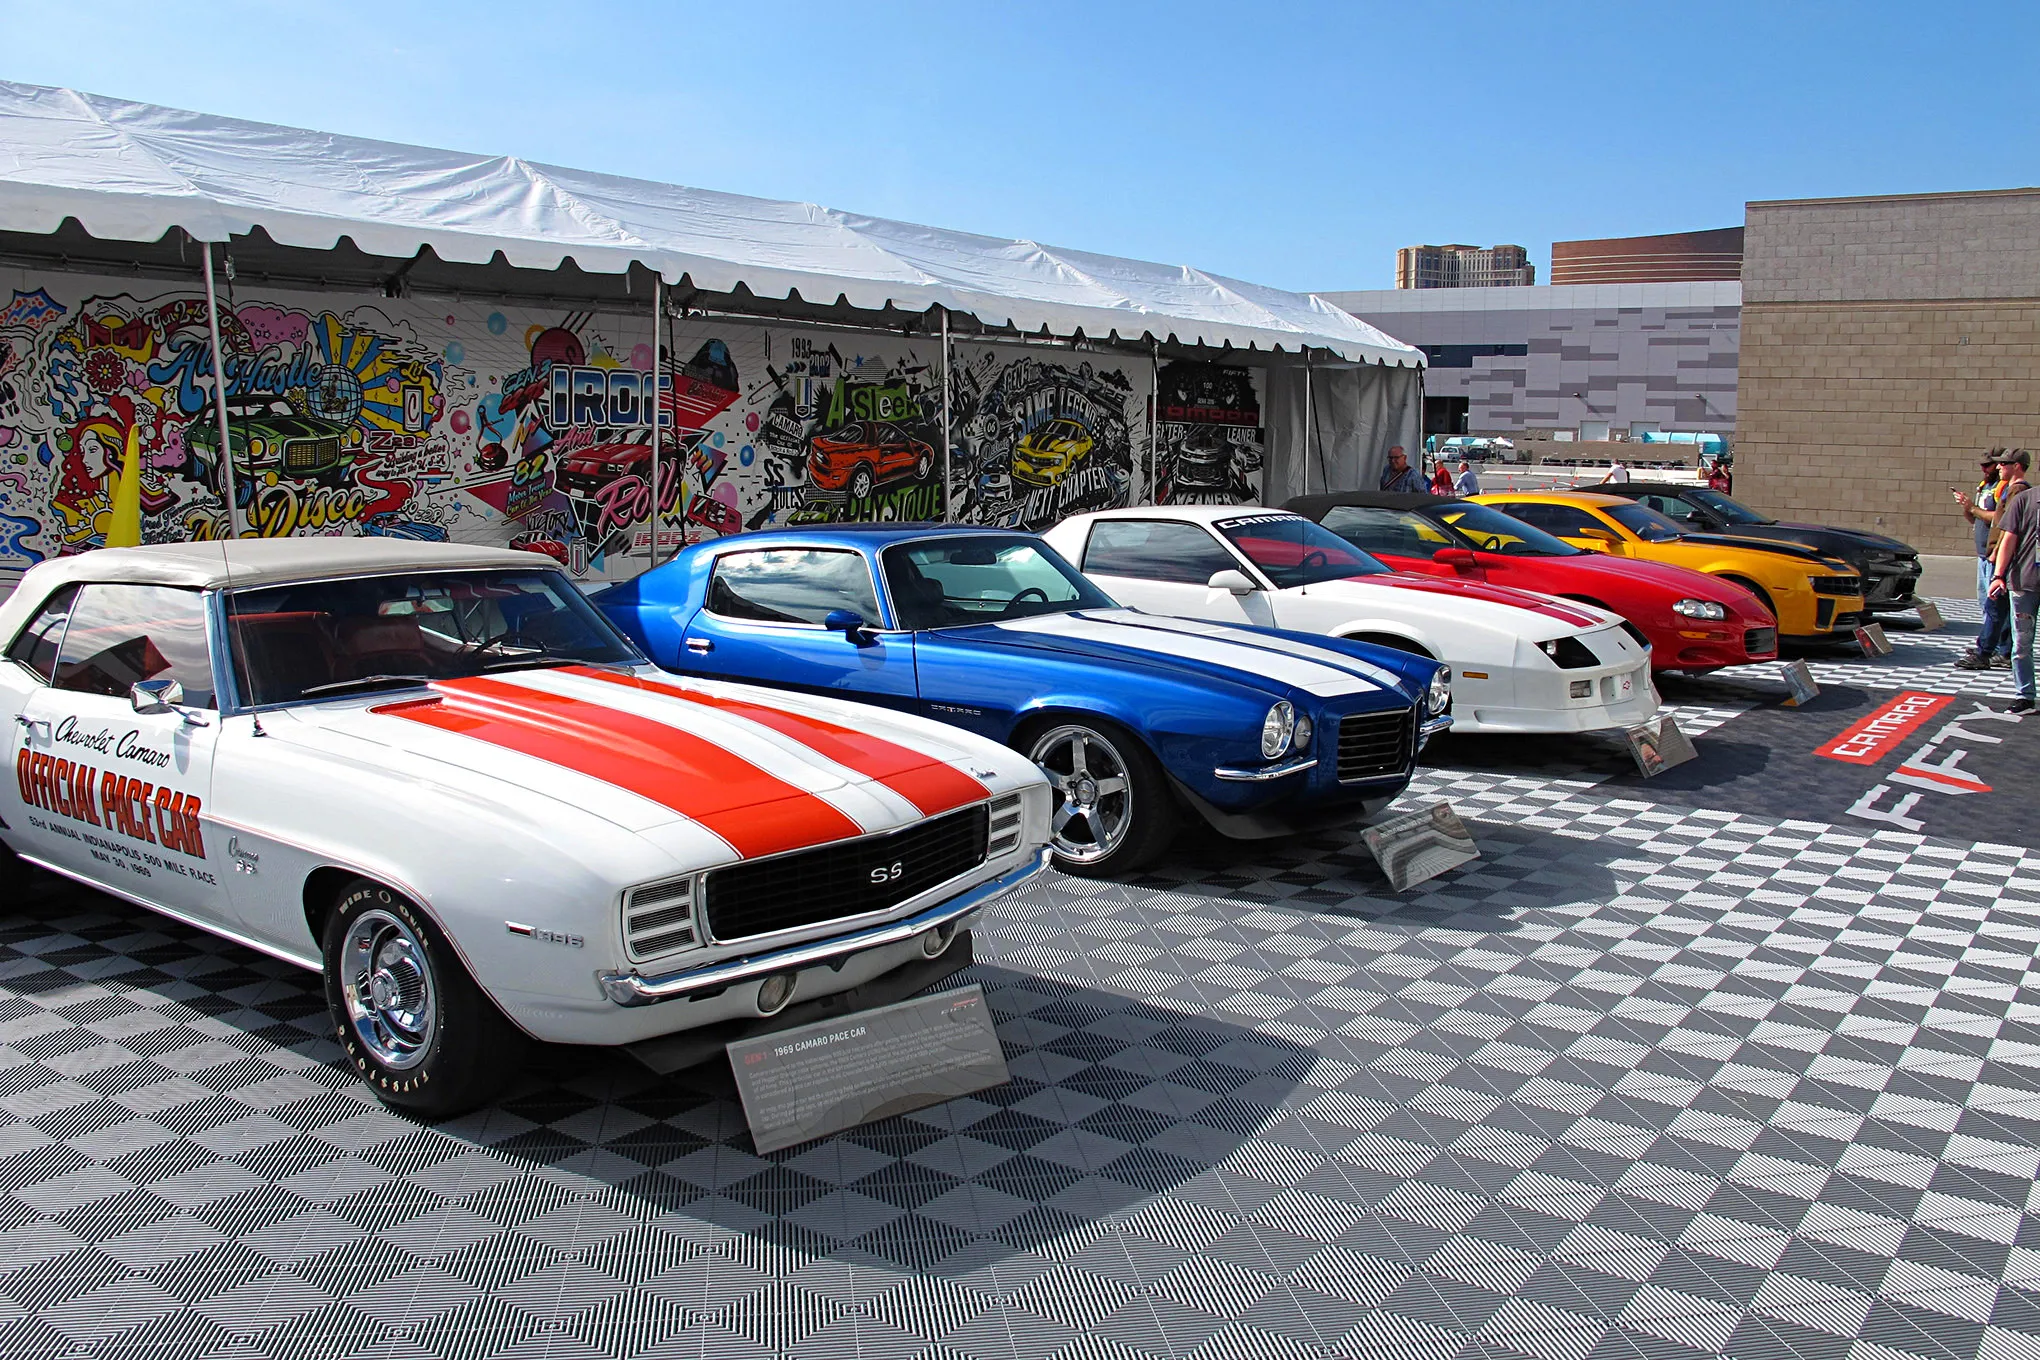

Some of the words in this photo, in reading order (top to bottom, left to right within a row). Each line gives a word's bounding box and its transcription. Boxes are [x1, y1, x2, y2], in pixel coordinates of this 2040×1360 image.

[791, 337, 812, 359] 1993
[551, 364, 674, 429] IROC
[826, 377, 845, 428] A
[854, 388, 920, 421] Sleek
[1015, 387, 1056, 438] SAME
[1060, 386, 1098, 432] LEGEND
[551, 425, 596, 454] And
[773, 413, 804, 438] CAMARO
[1146, 423, 1184, 439] LGHTER
[1227, 427, 1256, 442] LEANER
[513, 454, 545, 485] 82
[764, 458, 785, 486] SS
[402, 498, 418, 515] 80
[595, 458, 679, 540] Roll
[772, 487, 805, 512] RULES
[1026, 482, 1056, 522] NEXT
[1057, 467, 1109, 509] CHAPTER
[247, 484, 365, 538] Disco
[526, 509, 570, 534] VICTORY
[55, 715, 115, 755] Chevrolet
[116, 729, 170, 768] Camaro
[1832, 695, 1938, 757] CAMARO
[1845, 701, 2023, 832] FIFTY
[17, 747, 102, 828] OFFICIAL
[101, 771, 157, 845] PACE
[154, 786, 207, 860] CAR
[29, 815, 47, 830] 53rd
[50, 823, 82, 842] ANNUAL
[83, 833, 142, 861] INDIANAPOLIS
[143, 854, 162, 868] 500
[164, 860, 187, 876] MILE
[189, 867, 217, 886] RACE
[92, 849, 111, 864] MAY
[112, 856, 129, 871] 30,
[130, 863, 151, 878] 1969
[870, 862, 902, 883] SS
[774, 1044, 794, 1058] 1969
[794, 1036, 828, 1053] CAMARO
[829, 1030, 850, 1045] PACE
[850, 1026, 866, 1040] CAR
